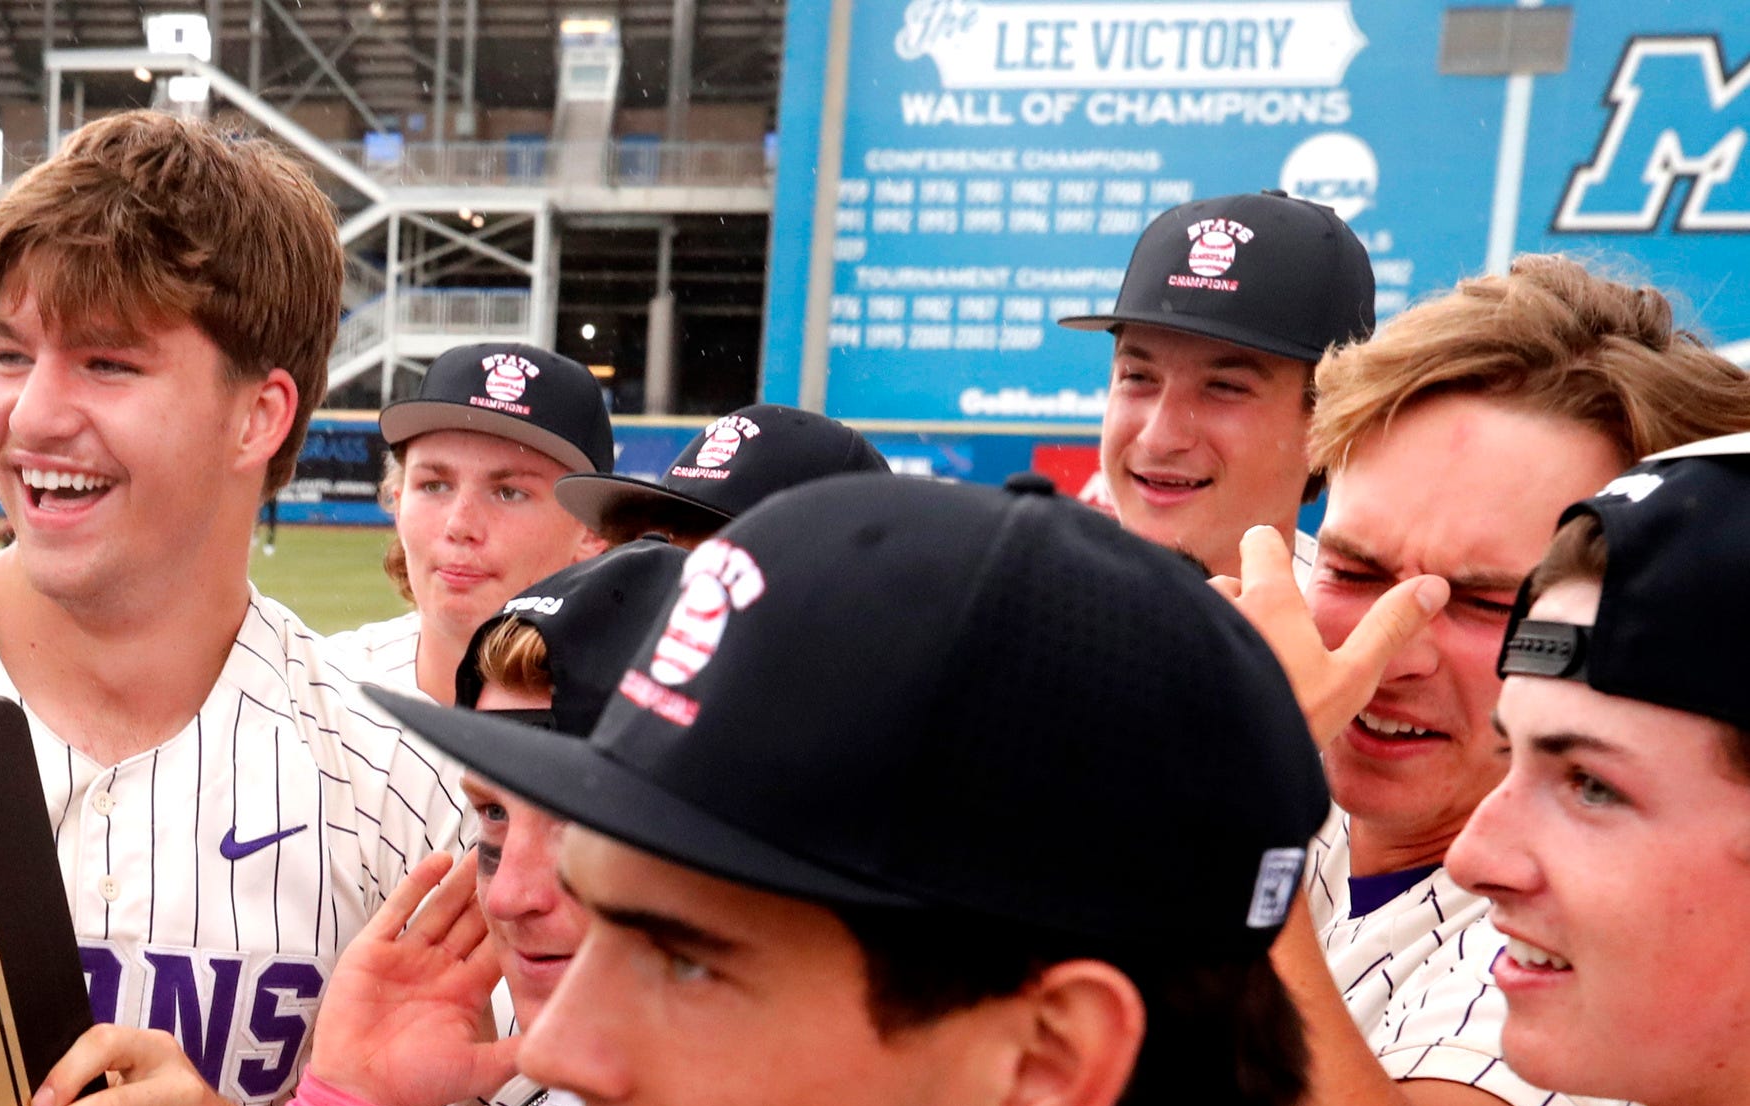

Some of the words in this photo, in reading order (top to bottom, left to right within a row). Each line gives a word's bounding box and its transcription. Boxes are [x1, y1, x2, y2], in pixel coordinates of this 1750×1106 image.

[994, 20, 1077, 71] LEE
[1091, 18, 1295, 71] VICTORY
[900, 92, 1016, 126] WALL
[1020, 92, 1080, 126] OF
[1084, 90, 1353, 126] CHAMPIONS
[865, 148, 1016, 172] CONFERENCE
[1020, 149, 1163, 172] CHAMPIONS
[1187, 217, 1255, 245] STATE
[856, 267, 1011, 290] TOURNAMENT
[1015, 268, 1123, 290] CHAMPIO
[1167, 274, 1239, 292] CHAMPIONS
[480, 353, 541, 379] STATE
[469, 395, 532, 416] CHAMPIONS
[671, 465, 731, 480] CHAMPIONS
